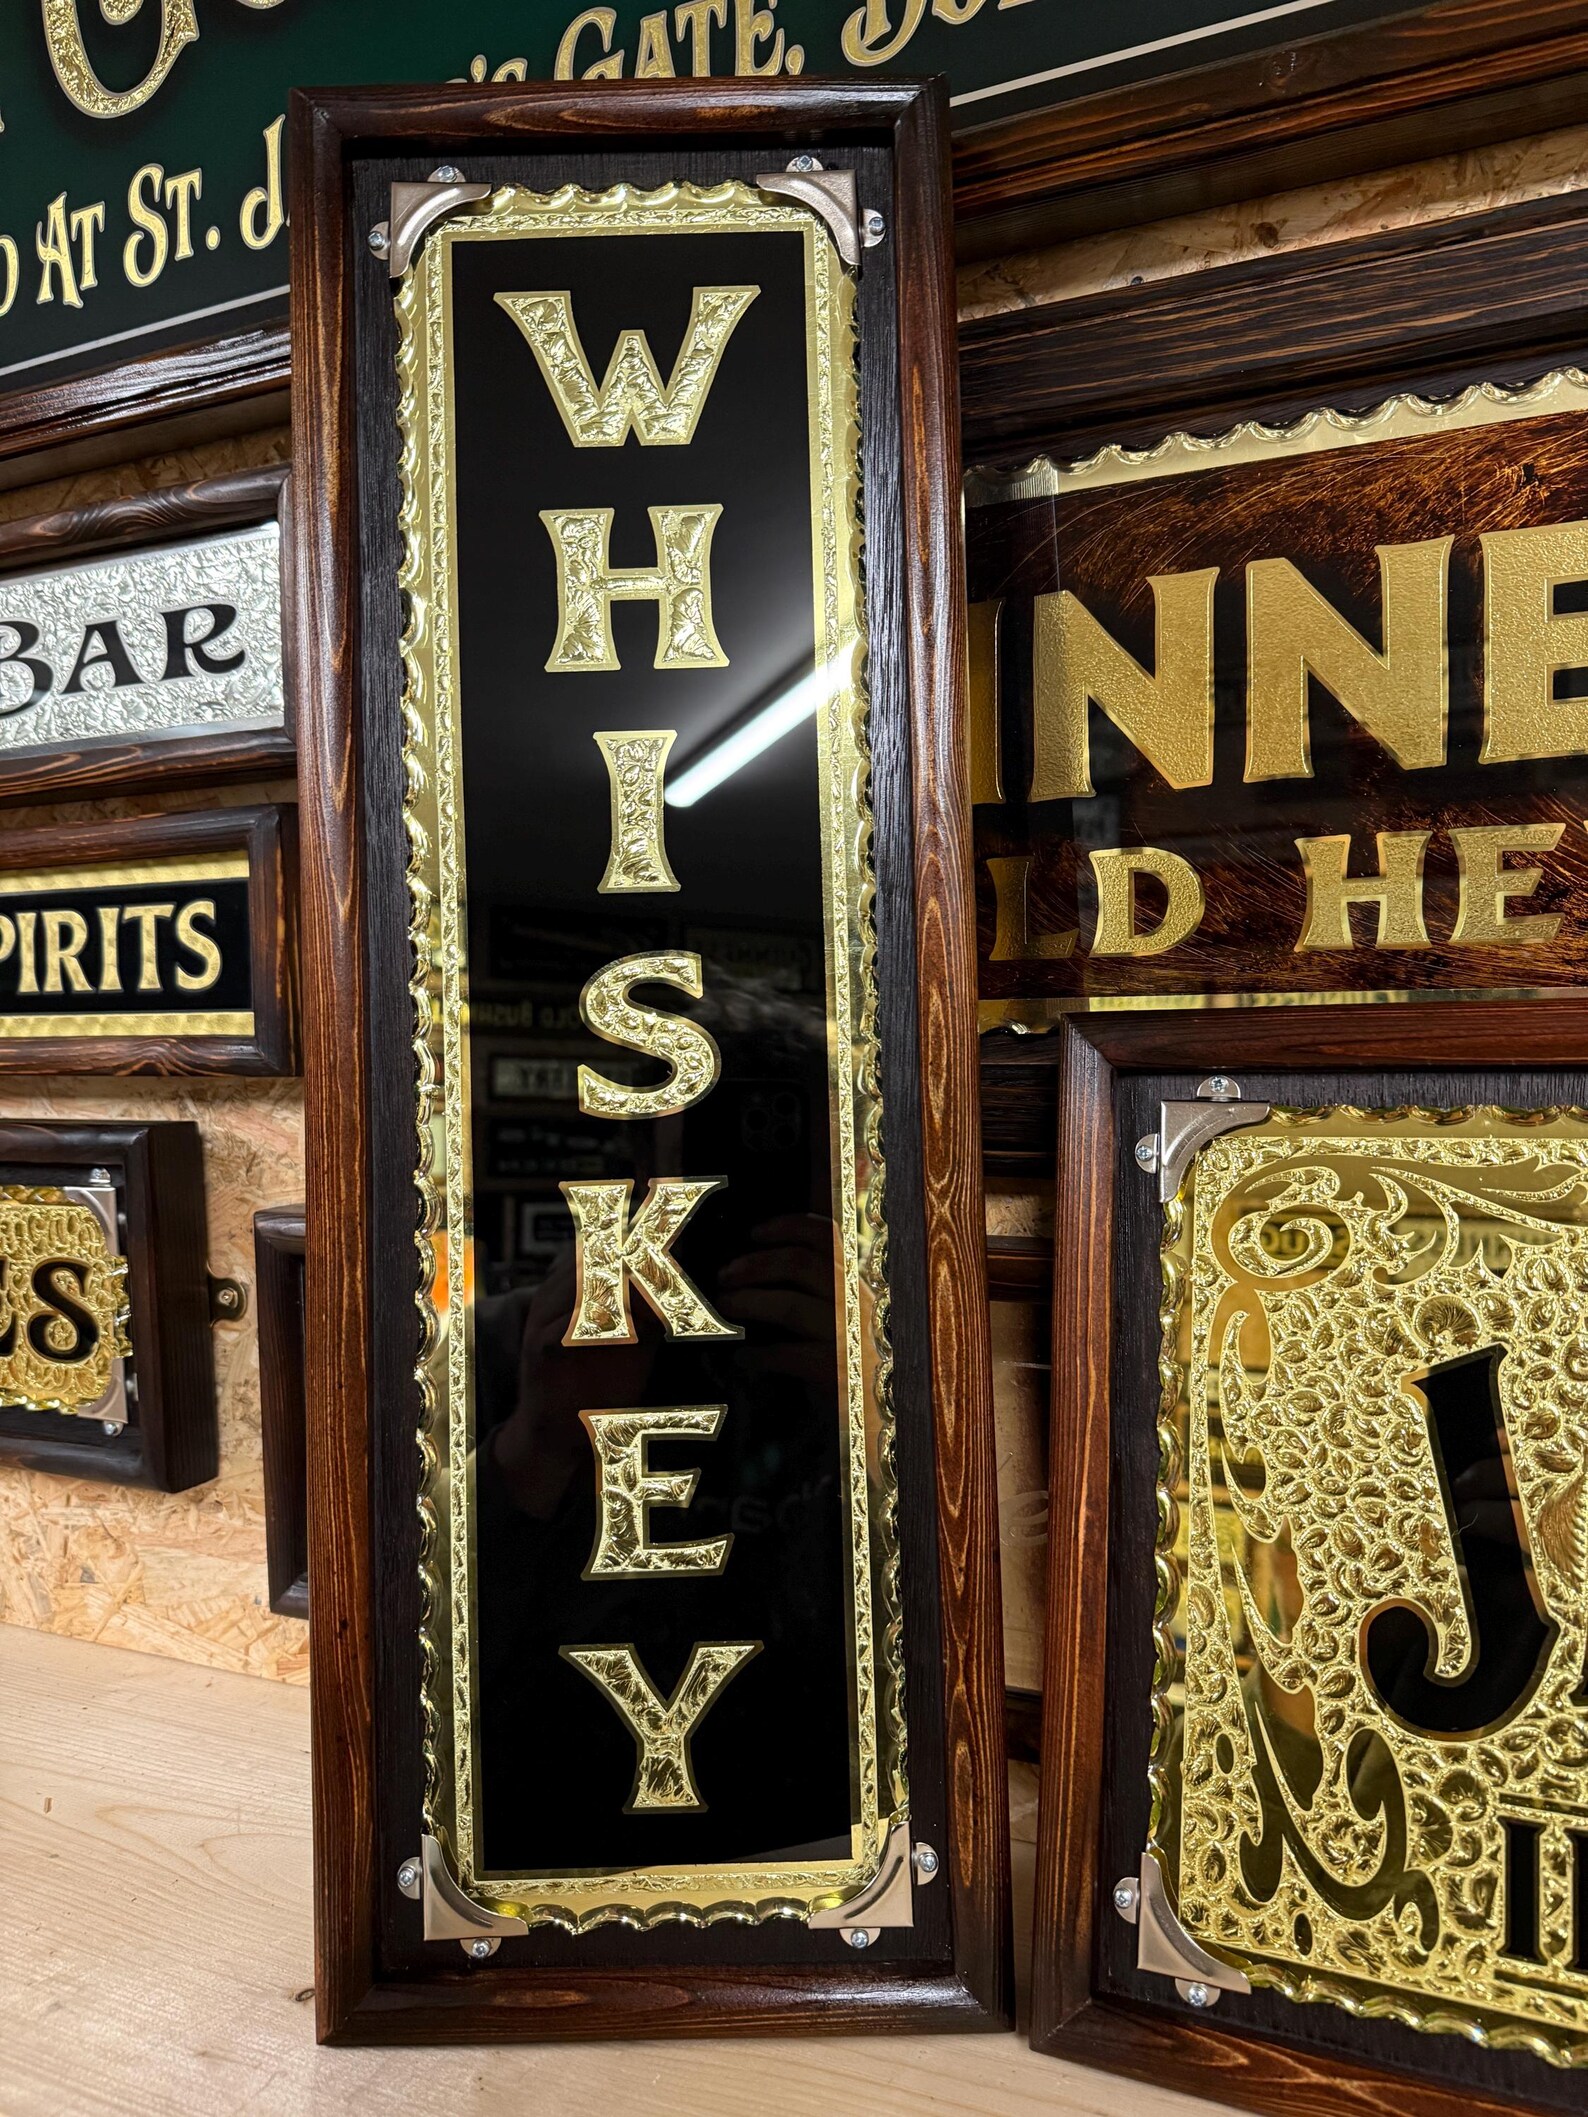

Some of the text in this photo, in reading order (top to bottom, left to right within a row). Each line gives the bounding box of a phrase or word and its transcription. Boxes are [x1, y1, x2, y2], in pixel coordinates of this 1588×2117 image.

[36, 191, 105, 309] AT
[123, 163, 221, 287] ST.
[0, 602, 247, 718] BAR
